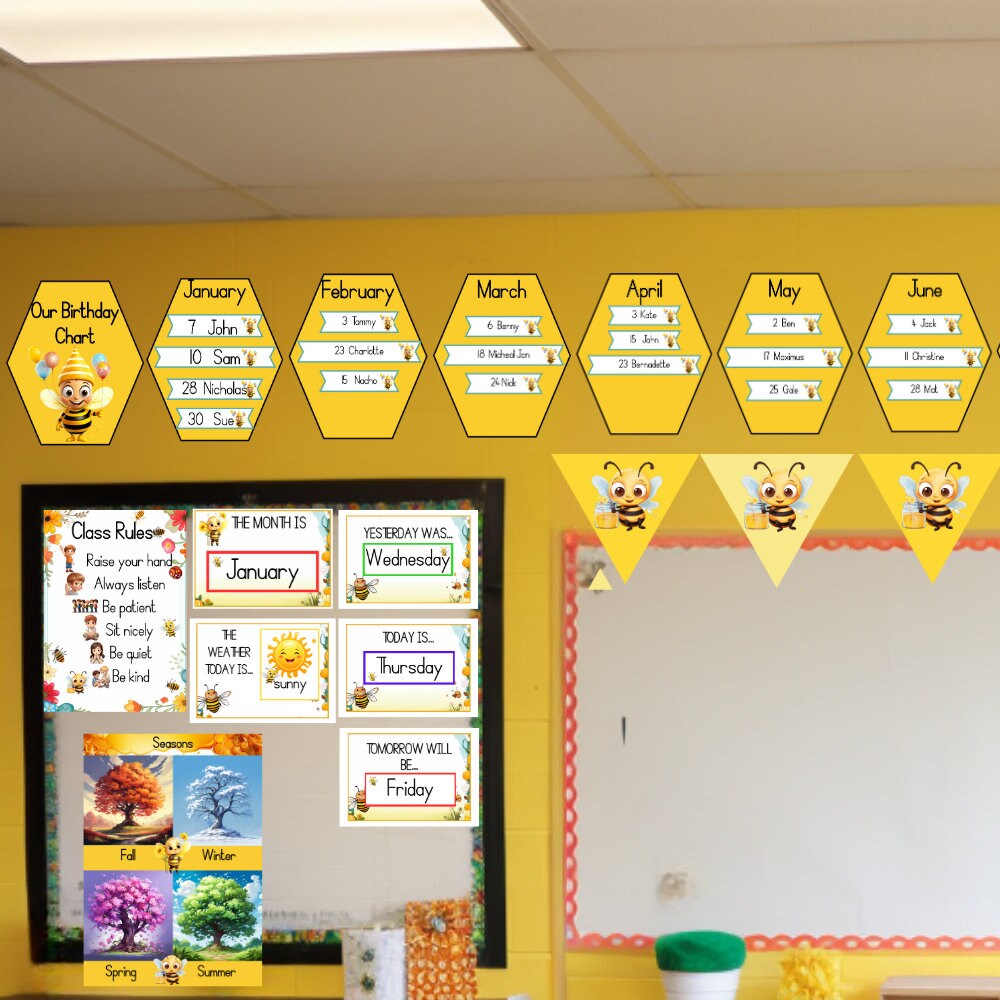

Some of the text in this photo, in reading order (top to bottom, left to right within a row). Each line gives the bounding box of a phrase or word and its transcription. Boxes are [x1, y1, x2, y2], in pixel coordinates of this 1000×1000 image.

[183, 278, 247, 306] January
[320, 279, 395, 306] February
[478, 280, 526, 298] March
[626, 279, 662, 305] April
[769, 279, 800, 305] May
[908, 279, 942, 297] June
[30, 301, 120, 325] Our Birthday
[641, 310, 656, 318] Kate
[188, 319, 238, 336] 7 John
[782, 318, 795, 327] Ben
[55, 327, 95, 344] Chart
[190, 348, 240, 364] 10 Sam
[335, 346, 383, 355] 23 Charlotte
[478, 349, 485, 358] 18
[913, 352, 944, 360] Christine
[619, 359, 628, 368] 23
[182, 379, 247, 395] 28 Nicholas
[770, 385, 778, 394] 25
[911, 384, 921, 393] 28
[188, 408, 235, 425] 30 Sue
[72, 521, 153, 539] Class Rules
[232, 516, 306, 529] THE MONTH IS
[364, 527, 418, 539] YESTERDAY
[87, 553, 173, 571] Raise your hand
[366, 549, 450, 573] Wednesday
[227, 558, 299, 588] January
[94, 577, 165, 595] Always listen
[103, 600, 156, 618] Be patient
[106, 623, 153, 641] Sit nicely
[222, 630, 236, 640] THE
[383, 632, 414, 643] TODAY
[110, 646, 152, 664] Be quiet
[208, 647, 250, 657] WEATHER
[113, 669, 149, 682] Be kind
[205, 664, 234, 674] TODAY
[376, 657, 442, 681] Thursday
[273, 677, 306, 694] sunny
[153, 736, 193, 748] Seasons
[367, 743, 452, 754] TOMORROW WILL
[387, 778, 433, 803] Friday
[121, 849, 236, 860] Fall Winter
[106, 965, 236, 982] Spring Summer
